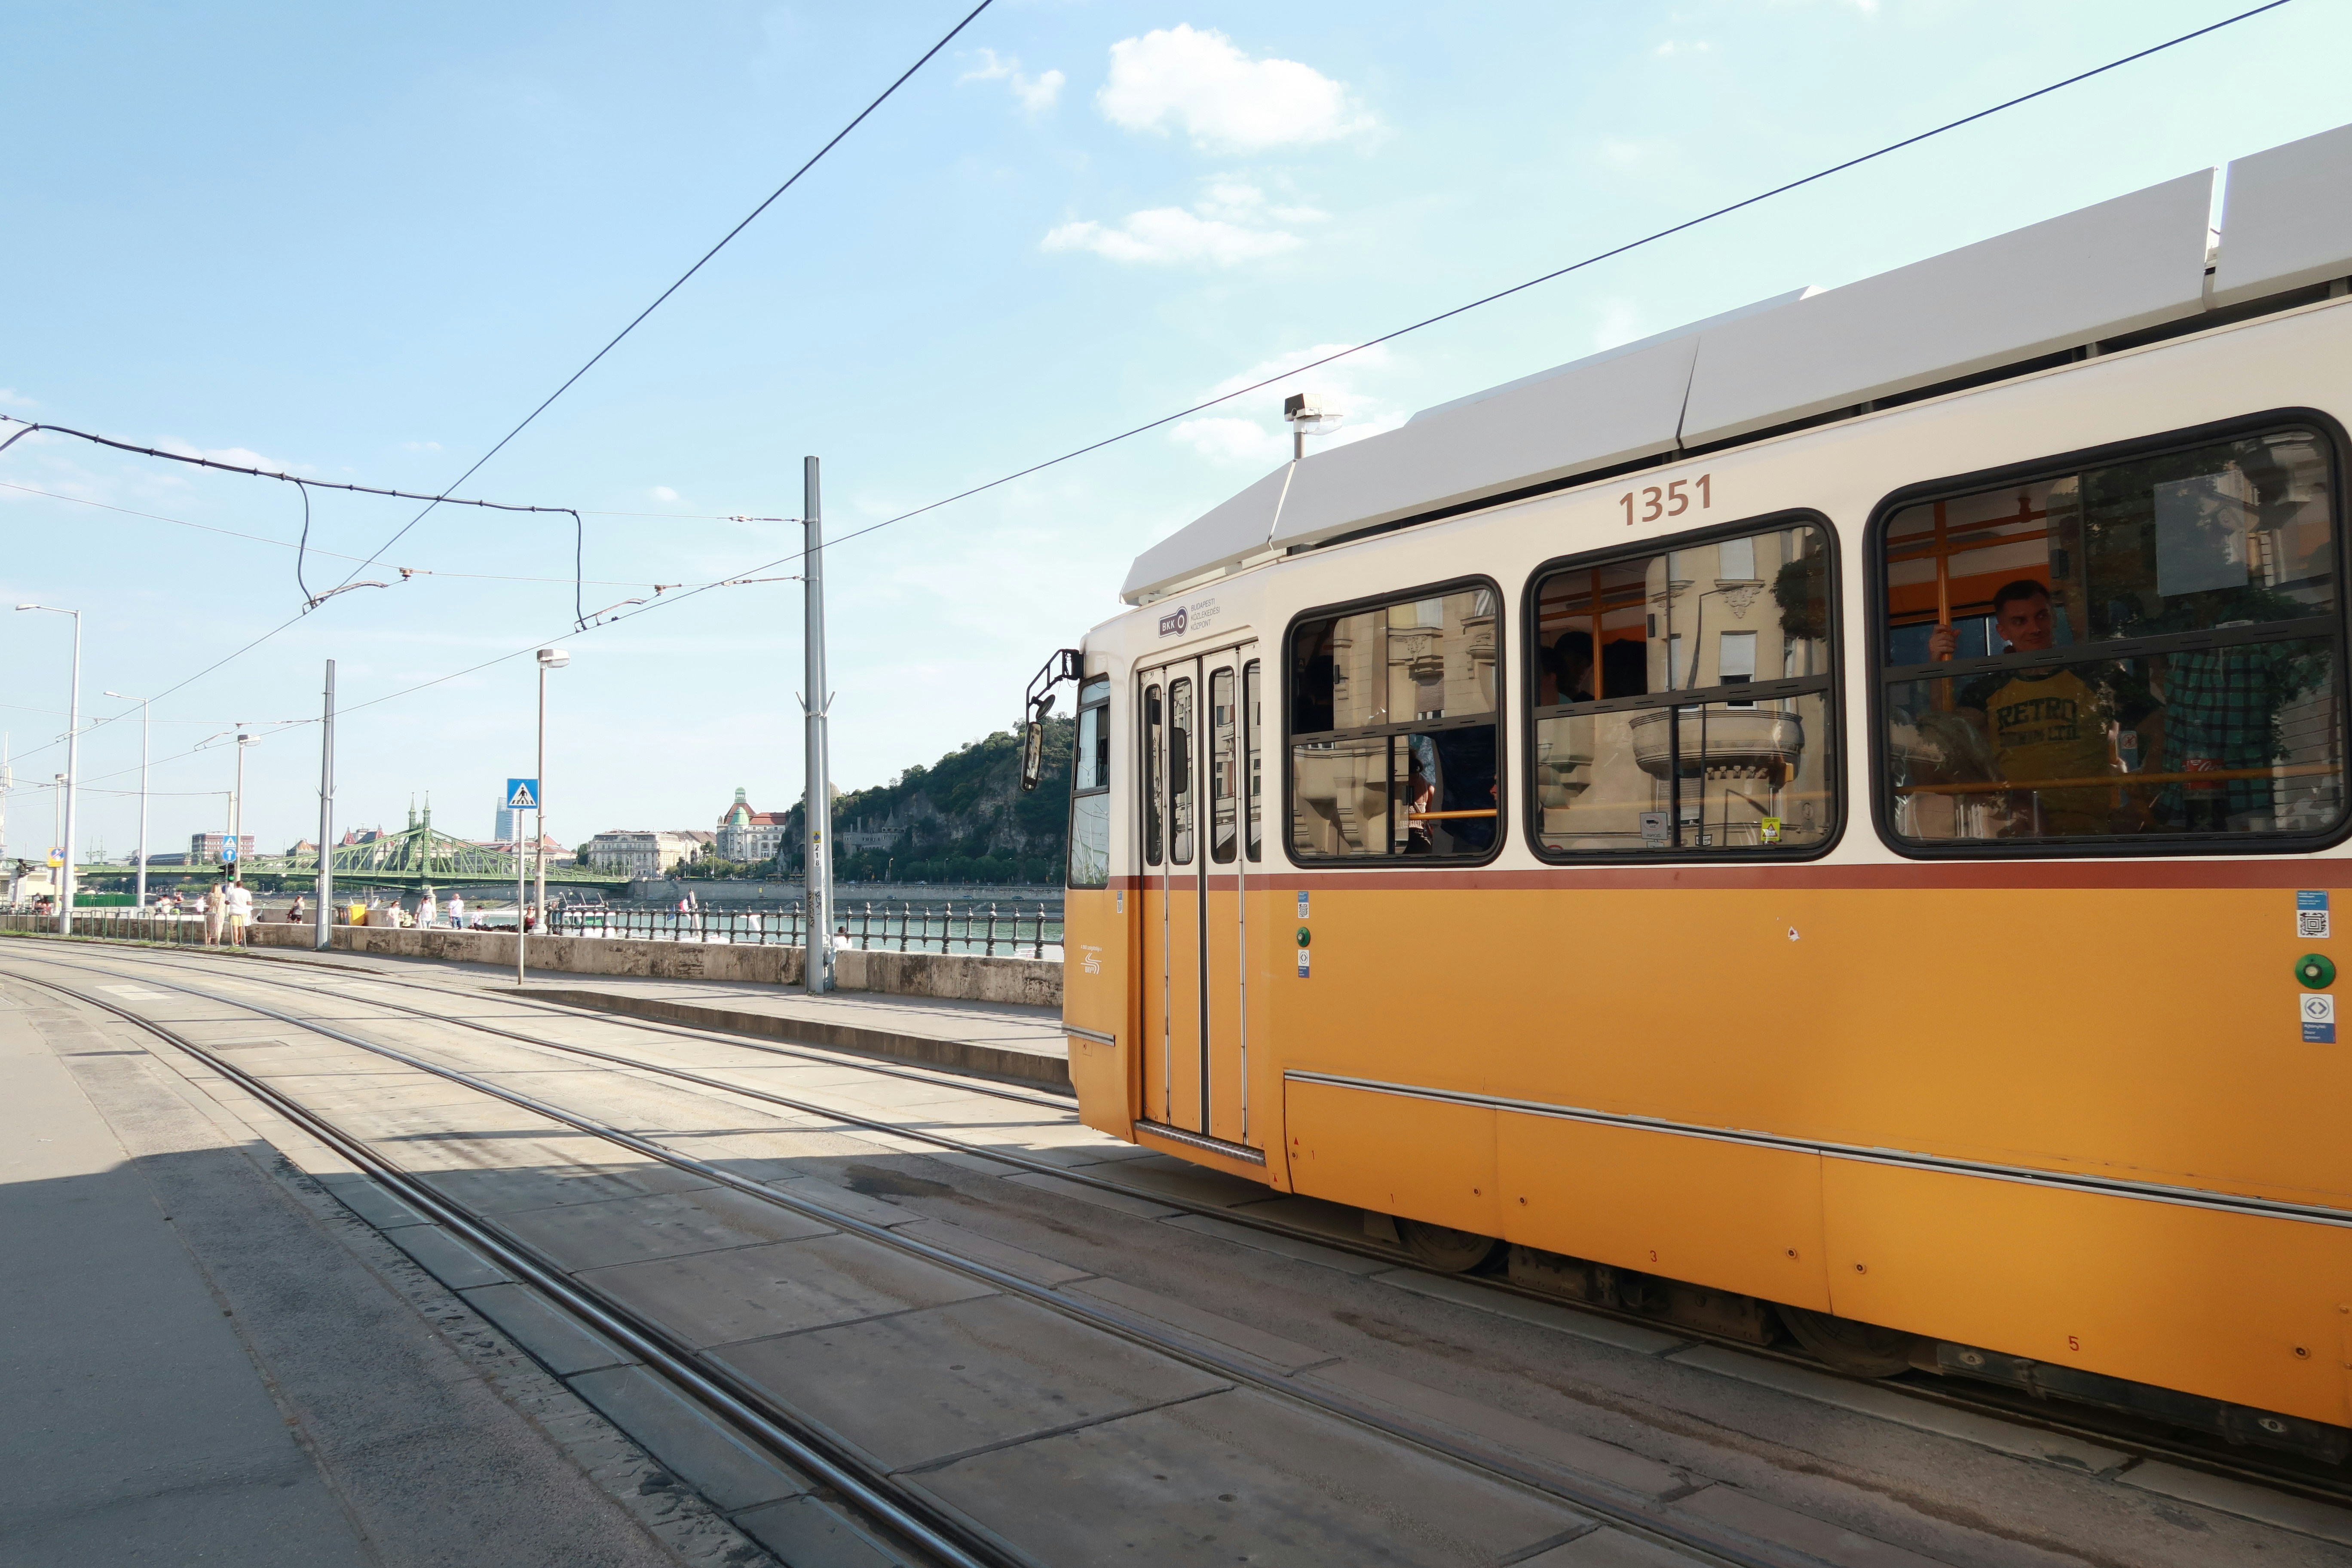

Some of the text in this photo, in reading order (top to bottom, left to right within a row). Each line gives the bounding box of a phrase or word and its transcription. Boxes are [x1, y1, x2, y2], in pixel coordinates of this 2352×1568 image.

[1620, 474, 1710, 526] 1351
[1191, 598, 1215, 612] BUDAPESTI
[1162, 619, 1175, 631] BKK
[1997, 697, 2078, 732] RETRO
[1390, 1193, 1394, 1204] 1
[1650, 1250, 1657, 1262] 3
[2069, 1335, 2079, 1351] 5
